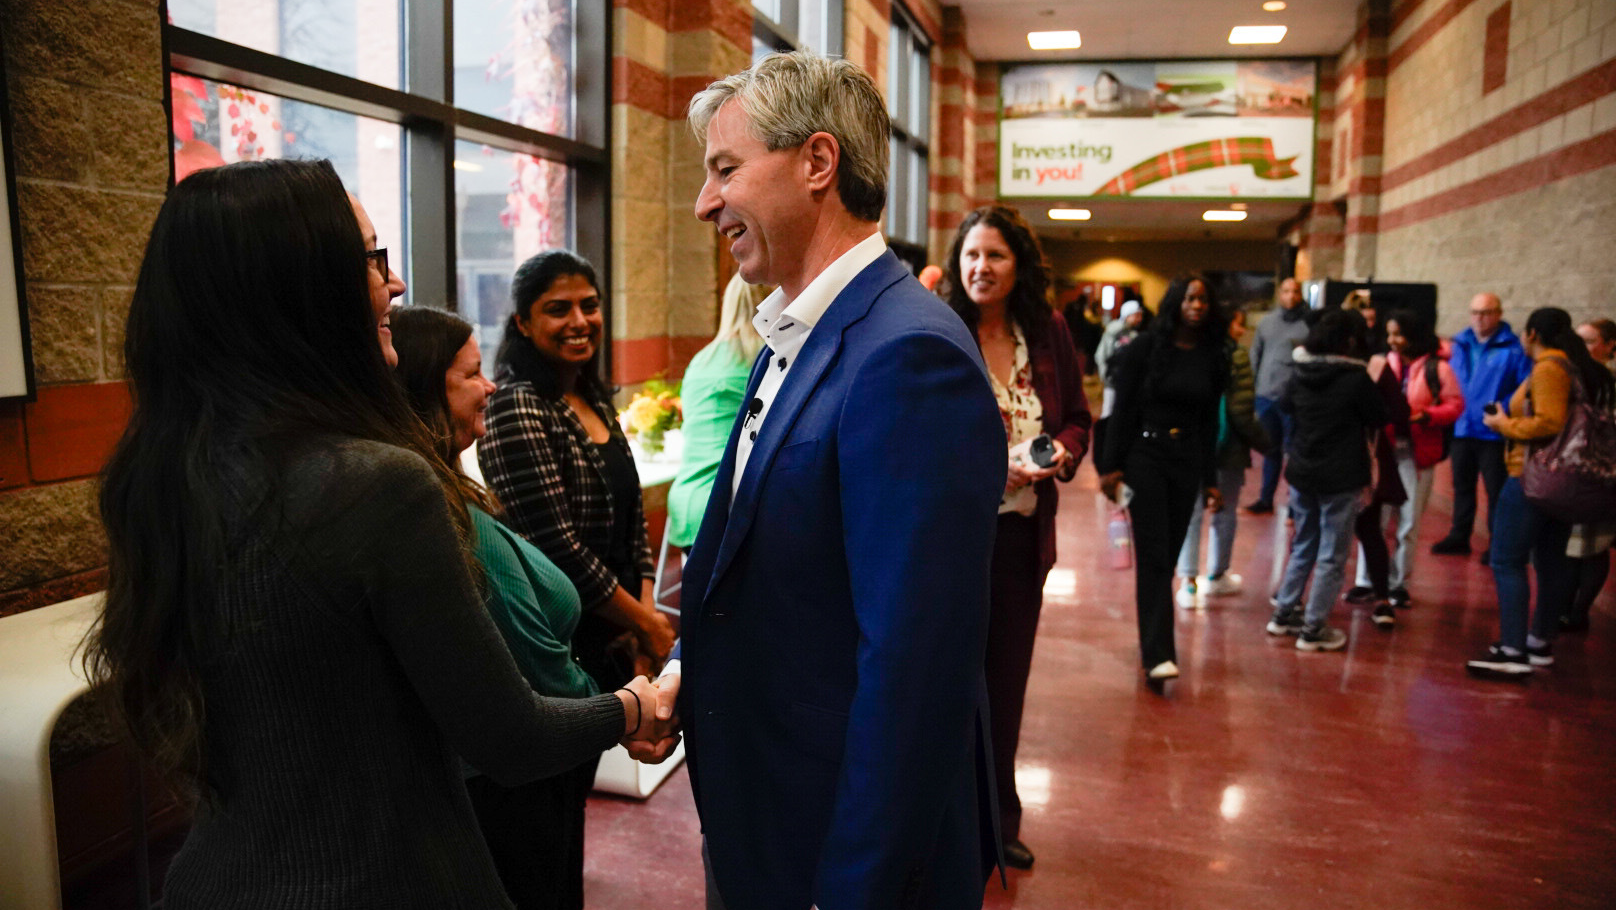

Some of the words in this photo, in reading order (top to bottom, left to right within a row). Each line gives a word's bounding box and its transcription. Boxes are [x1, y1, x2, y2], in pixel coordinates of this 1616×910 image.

[1012, 141, 1112, 164] Investing
[1012, 161, 1030, 180] in
[1036, 162, 1083, 186] you!
